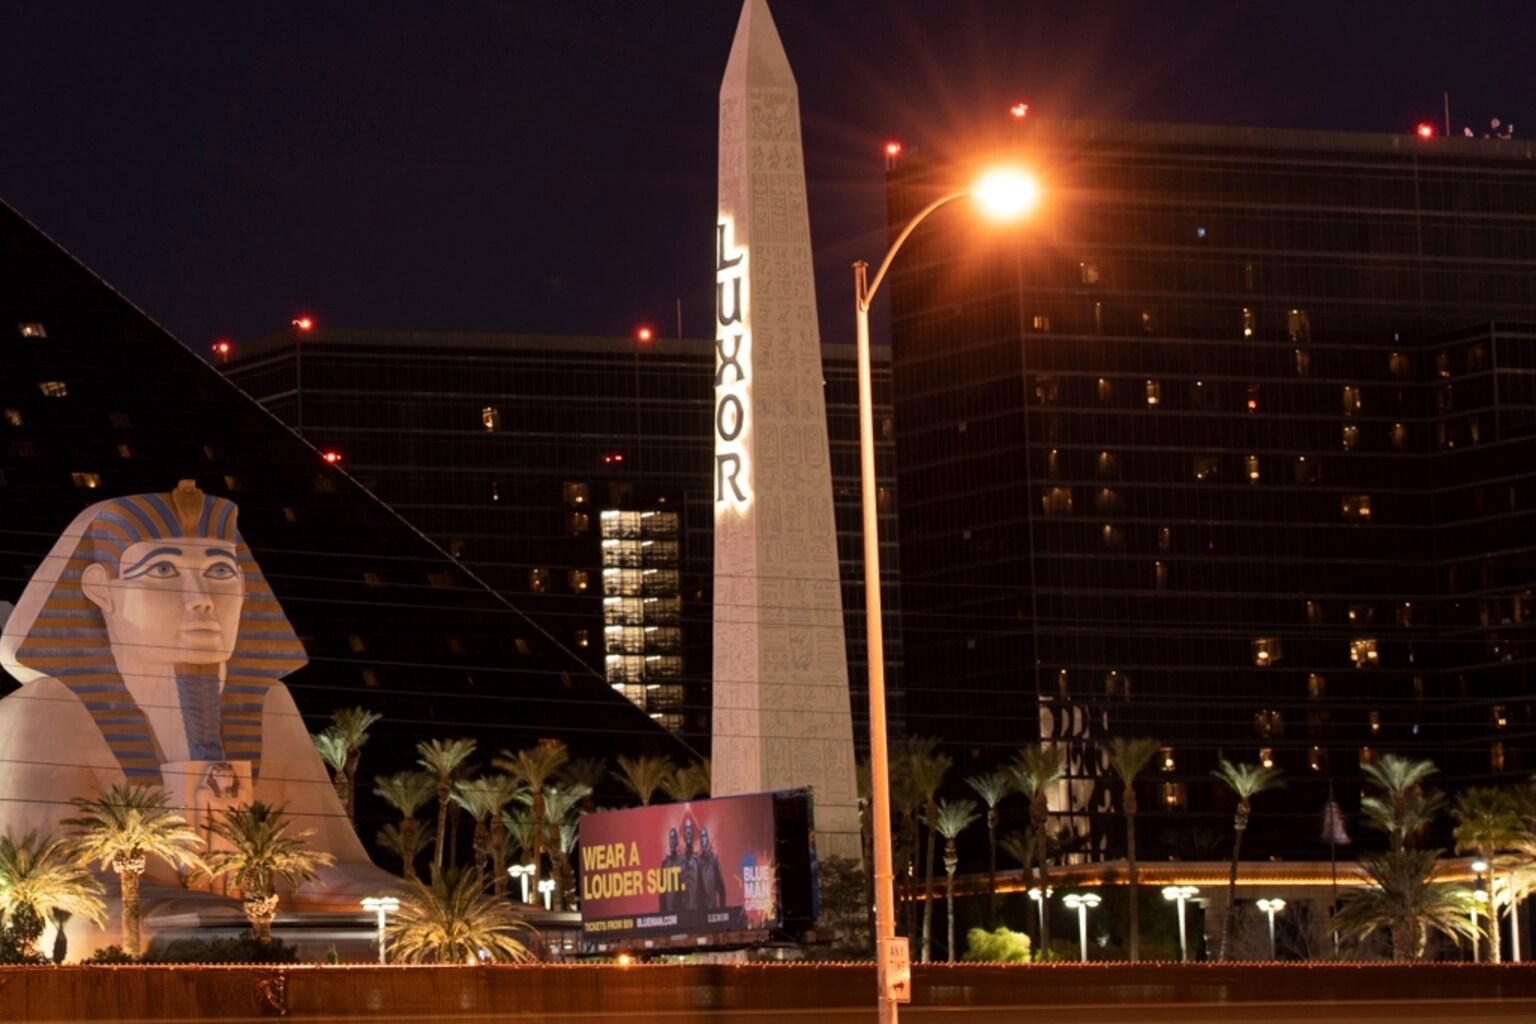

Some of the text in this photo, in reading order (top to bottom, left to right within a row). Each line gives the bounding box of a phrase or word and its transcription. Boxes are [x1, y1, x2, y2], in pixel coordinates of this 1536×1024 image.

[715, 222, 748, 504] LUXOR
[582, 841, 641, 871] WEAR A
[584, 866, 686, 900] LOUDER SUIT.
